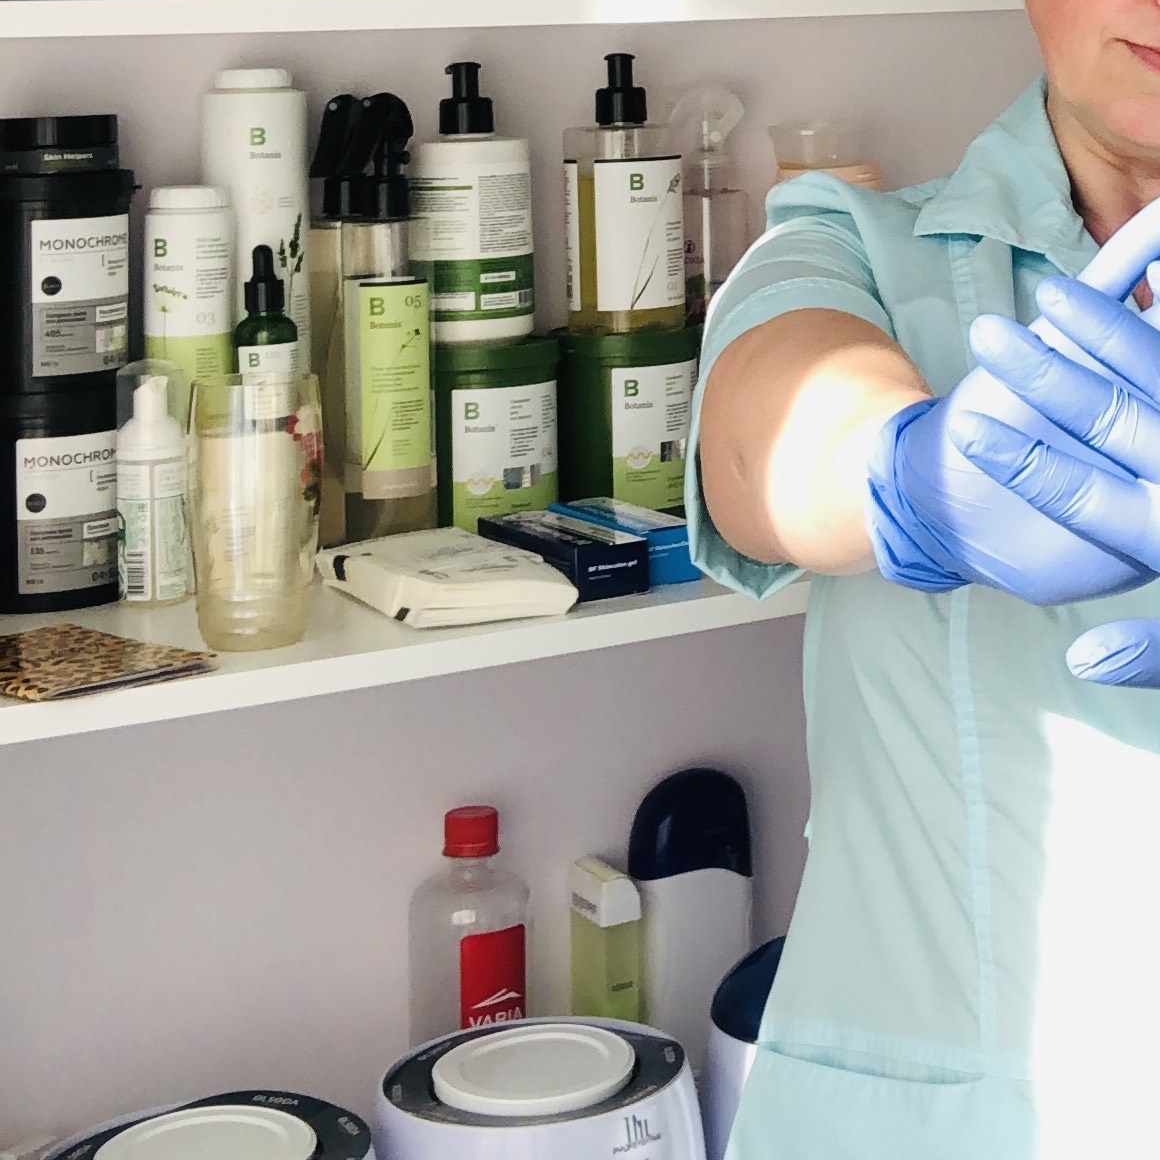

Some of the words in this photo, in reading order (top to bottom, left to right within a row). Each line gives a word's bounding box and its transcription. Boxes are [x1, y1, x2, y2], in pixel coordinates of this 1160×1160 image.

[250, 127, 266, 146] B
[630, 173, 644, 191] B
[154, 238, 167, 257] B
[370, 297, 385, 316] B
[405, 295, 421, 309] 05
[196, 311, 216, 326] 03
[249, 352, 260, 368] B
[624, 379, 639, 397] B
[464, 402, 480, 420] B
